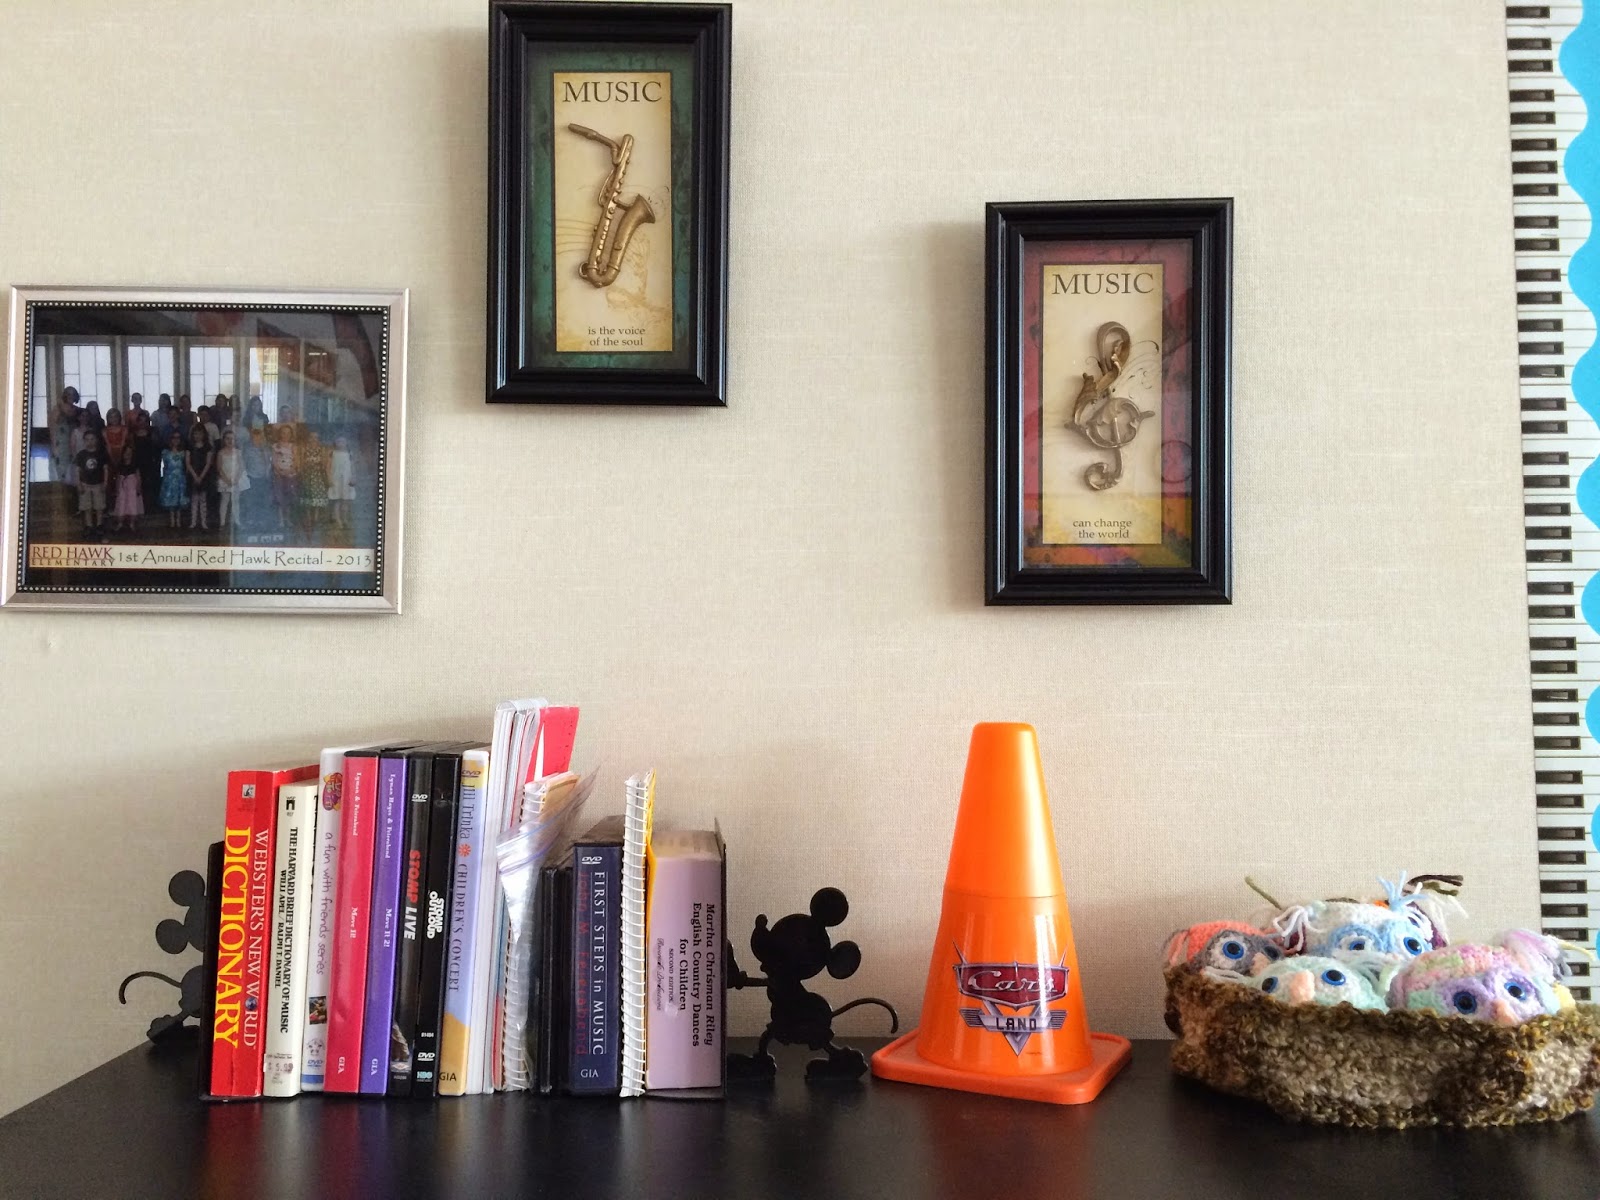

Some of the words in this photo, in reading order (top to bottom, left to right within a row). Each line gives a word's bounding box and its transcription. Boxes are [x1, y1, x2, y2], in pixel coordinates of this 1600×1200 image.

[562, 81, 663, 103] MUSIC
[1052, 272, 1154, 295] MUSIC
[588, 326, 596, 335] is
[600, 326, 615, 335] the
[618, 326, 646, 335] voice
[589, 337, 600, 346] of
[603, 337, 619, 346] the
[622, 337, 643, 346] soul
[1073, 520, 1091, 528] can
[1094, 518, 1132, 530] change
[1079, 530, 1095, 538] the
[1098, 530, 1129, 538] world
[32, 559, 115, 567] ELEMENTARY
[33, 546, 62, 559] RED
[67, 547, 115, 560] HAWK
[119, 552, 138, 562] 1st
[141, 549, 193, 565] Annual
[197, 550, 225, 566] Red
[230, 550, 271, 566] Hawk
[275, 551, 323, 566] Recital
[336, 554, 372, 568] 2013
[354, 772, 362, 794] Lyman
[388, 774, 396, 795] Lyman
[461, 769, 481, 778] DVD
[412, 794, 428, 802] DVD
[460, 804, 474, 839] Trinka
[289, 827, 298, 847] THE
[325, 832, 333, 840] a
[323, 844, 336, 864] fun
[581, 856, 602, 864] DVD
[250, 829, 269, 931] WEBSTER'S
[286, 848, 297, 895] HARVARD
[322, 869, 333, 893] with
[407, 850, 421, 903] STOMP
[453, 863, 468, 934] CHILDREN'S
[594, 872, 605, 917] FIRST
[285, 897, 294, 925] BRIEF
[319, 898, 333, 939] friends
[350, 907, 358, 928] Move
[385, 908, 393, 928] Move
[437, 898, 445, 933] STOMP
[384, 930, 391, 938] It
[404, 906, 418, 940] LIVE
[691, 902, 702, 947] English
[706, 903, 715, 948] Martha
[214, 827, 251, 1048] DICTIONARY
[383, 940, 391, 948] 2!
[593, 925, 605, 972] STEPS
[680, 938, 689, 956] for
[247, 936, 262, 978] NEW
[282, 926, 293, 986] DICTIONARY
[316, 943, 328, 975] series
[449, 938, 462, 992] CONCERT
[593, 980, 604, 992] in
[679, 959, 689, 1011] Children
[691, 950, 702, 1000] Country
[706, 951, 715, 1011] Chrisman
[281, 987, 290, 1001] OF
[280, 1001, 289, 1033] MUSIC
[593, 1000, 604, 1055] MUSIC
[692, 1003, 702, 1047] Dances
[996, 1017, 1037, 1031] LAND
[704, 1014, 715, 1046] Riley
[418, 1052, 435, 1061] DVD
[440, 1072, 457, 1081] GIA
[580, 1069, 599, 1078] GIA
